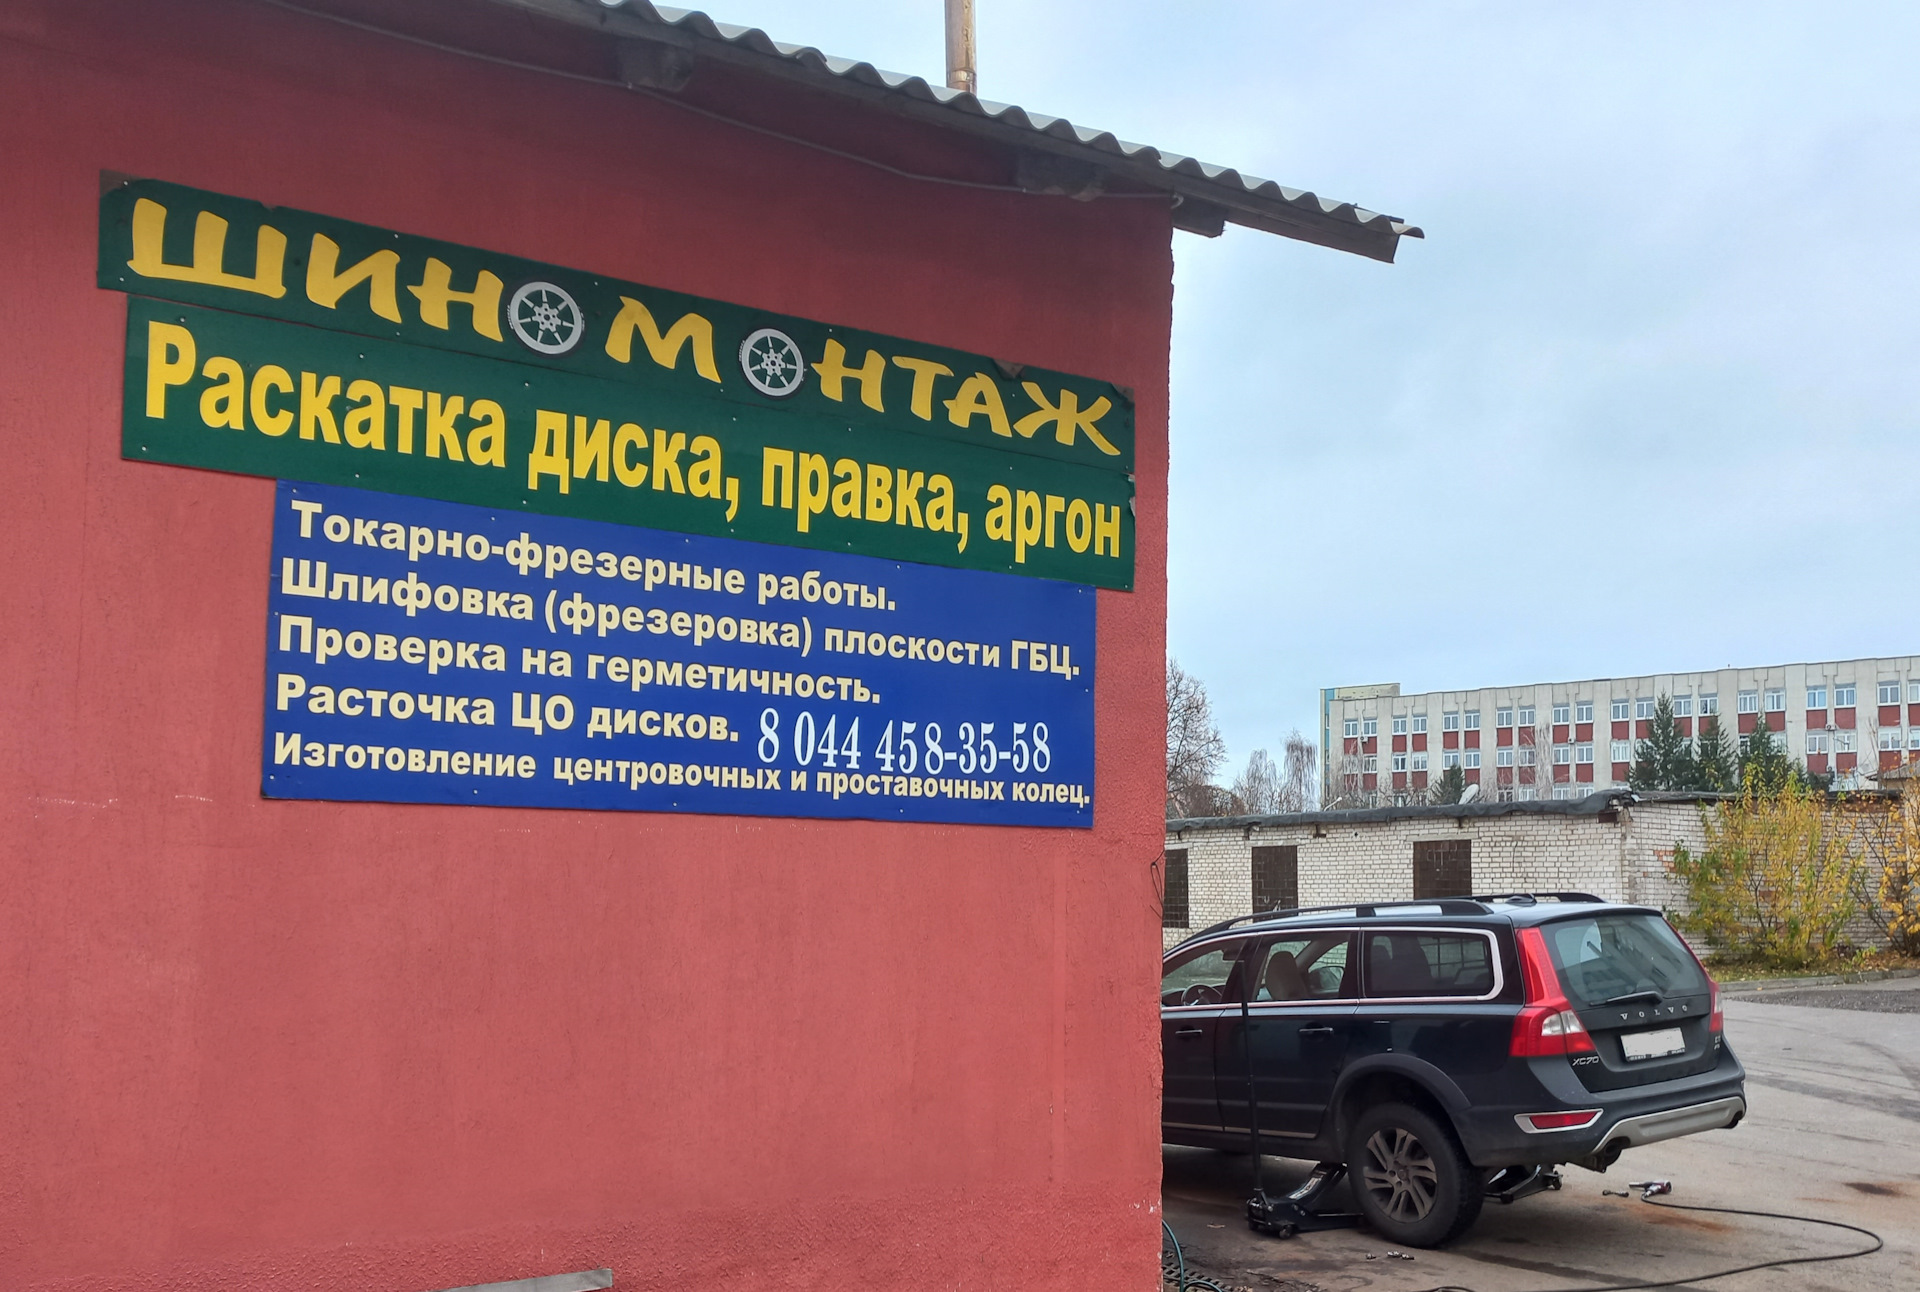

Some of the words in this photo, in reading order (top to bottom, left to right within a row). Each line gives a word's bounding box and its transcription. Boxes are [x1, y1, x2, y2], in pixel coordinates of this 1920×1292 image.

[146, 320, 506, 467] Раскатка
[528, 409, 740, 522] диска,
[762, 446, 969, 553] правка,
[985, 484, 1121, 563] аргон
[291, 500, 746, 593] Токарно-фрезерные
[757, 570, 896, 611] работы.
[281, 557, 534, 617] Шлифовка
[544, 589, 812, 657] (фрезеровка)
[824, 627, 1000, 668] плоскости
[1011, 639, 1080, 681] ГБЦ.
[279, 614, 506, 675] Проверка
[521, 647, 572, 677] на
[587, 654, 881, 704] герметичность.
[276, 673, 495, 726] Расточка
[511, 692, 575, 736] ЦО
[586, 706, 739, 742] дисков.
[757, 707, 780, 763] 8
[793, 711, 862, 769] 044
[874, 719, 1051, 775] 458-35-58
[274, 732, 537, 778] Изготовление
[553, 756, 781, 791] центровочных
[790, 770, 807, 792] и
[816, 771, 1005, 800] проставочных
[1012, 782, 1090, 809] колец.
[1620, 1004, 1688, 1020] VOLVO
[1572, 1055, 1600, 1067] XC70
